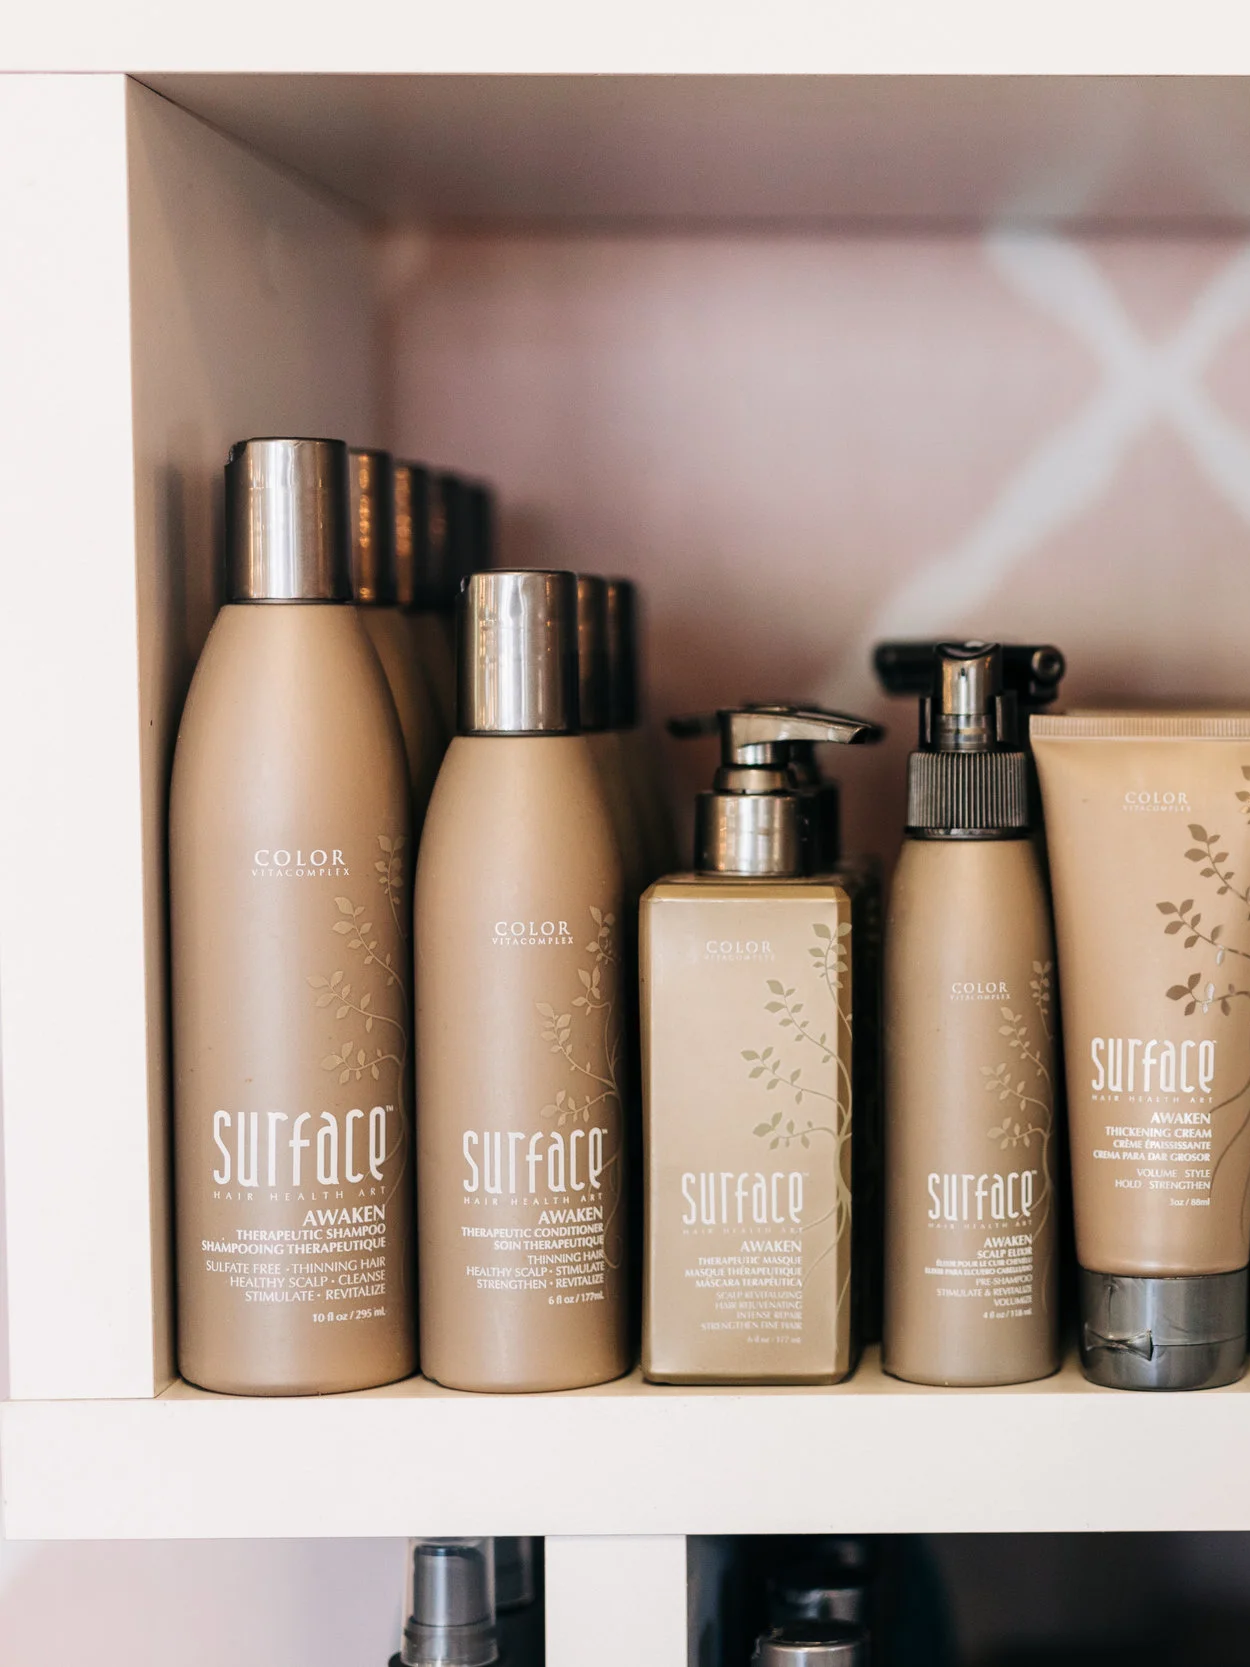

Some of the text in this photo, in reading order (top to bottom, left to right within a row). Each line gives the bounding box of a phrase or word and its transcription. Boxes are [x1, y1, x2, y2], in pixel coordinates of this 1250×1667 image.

[1124, 792, 1187, 804] COLOR
[254, 849, 345, 866] COLOR
[251, 868, 350, 877] VITACOMPLEX
[494, 921, 570, 936] COLOR
[492, 936, 574, 944] VITACOMPLEX
[706, 940, 771, 953] COLOR
[952, 982, 1008, 994] COLOR
[1150, 1112, 1211, 1124] AWAKEN
[1106, 1127, 1212, 1138] THICKENING CREAM
[1113, 1140, 1142, 1148] CRÈME
[1093, 1151, 1210, 1161] CREMA PARA DAR GROSOR
[1137, 1169, 1210, 1178] VOLUME STYLE
[1115, 1180, 1210, 1190] HOLD STRENGTHEN
[213, 1187, 386, 1201] HAIR HEALTH ART
[464, 1193, 603, 1206] HAIR HEALTH ART
[303, 1204, 385, 1226] AWAKEN
[538, 1206, 603, 1224] AWAKEN
[236, 1224, 386, 1240] THERAPEUTIC SHAMPOO
[461, 1224, 603, 1237] THERAPEUTIC CONDITIONER
[202, 1237, 386, 1254] SHAMPOOING THERAPEUTIQUE
[495, 1236, 604, 1251] SOIN THERAPEUTIQUE
[740, 1241, 801, 1252] AWAKEN
[984, 1234, 1032, 1248] AWAKEN
[528, 1249, 604, 1264] THINNING HAIR
[977, 1247, 1032, 1259] SCALP ELIXIR
[206, 1257, 386, 1274] SULFATE FREE THINNING HAIR
[698, 1256, 801, 1266] THERAPEUTIC MASQUE
[467, 1261, 604, 1277] HEALTHY SCALP STIMULATE
[685, 1269, 724, 1277] MASQUE
[230, 1271, 386, 1288] HEALTHY SCALP CLEANSE
[477, 1274, 604, 1289] STRENGTHEN REVITALIZE
[976, 1275, 1032, 1285] PRE-SHAMPOO
[245, 1284, 386, 1302] STIMULATE REVITALIZE
[937, 1288, 982, 1297] STIMULATE
[549, 1295, 554, 1305] 6
[557, 1295, 562, 1304] fl
[564, 1296, 574, 1304] oz
[313, 1314, 325, 1322] 10
[327, 1312, 334, 1321] fl
[356, 1310, 371, 1320] 295
